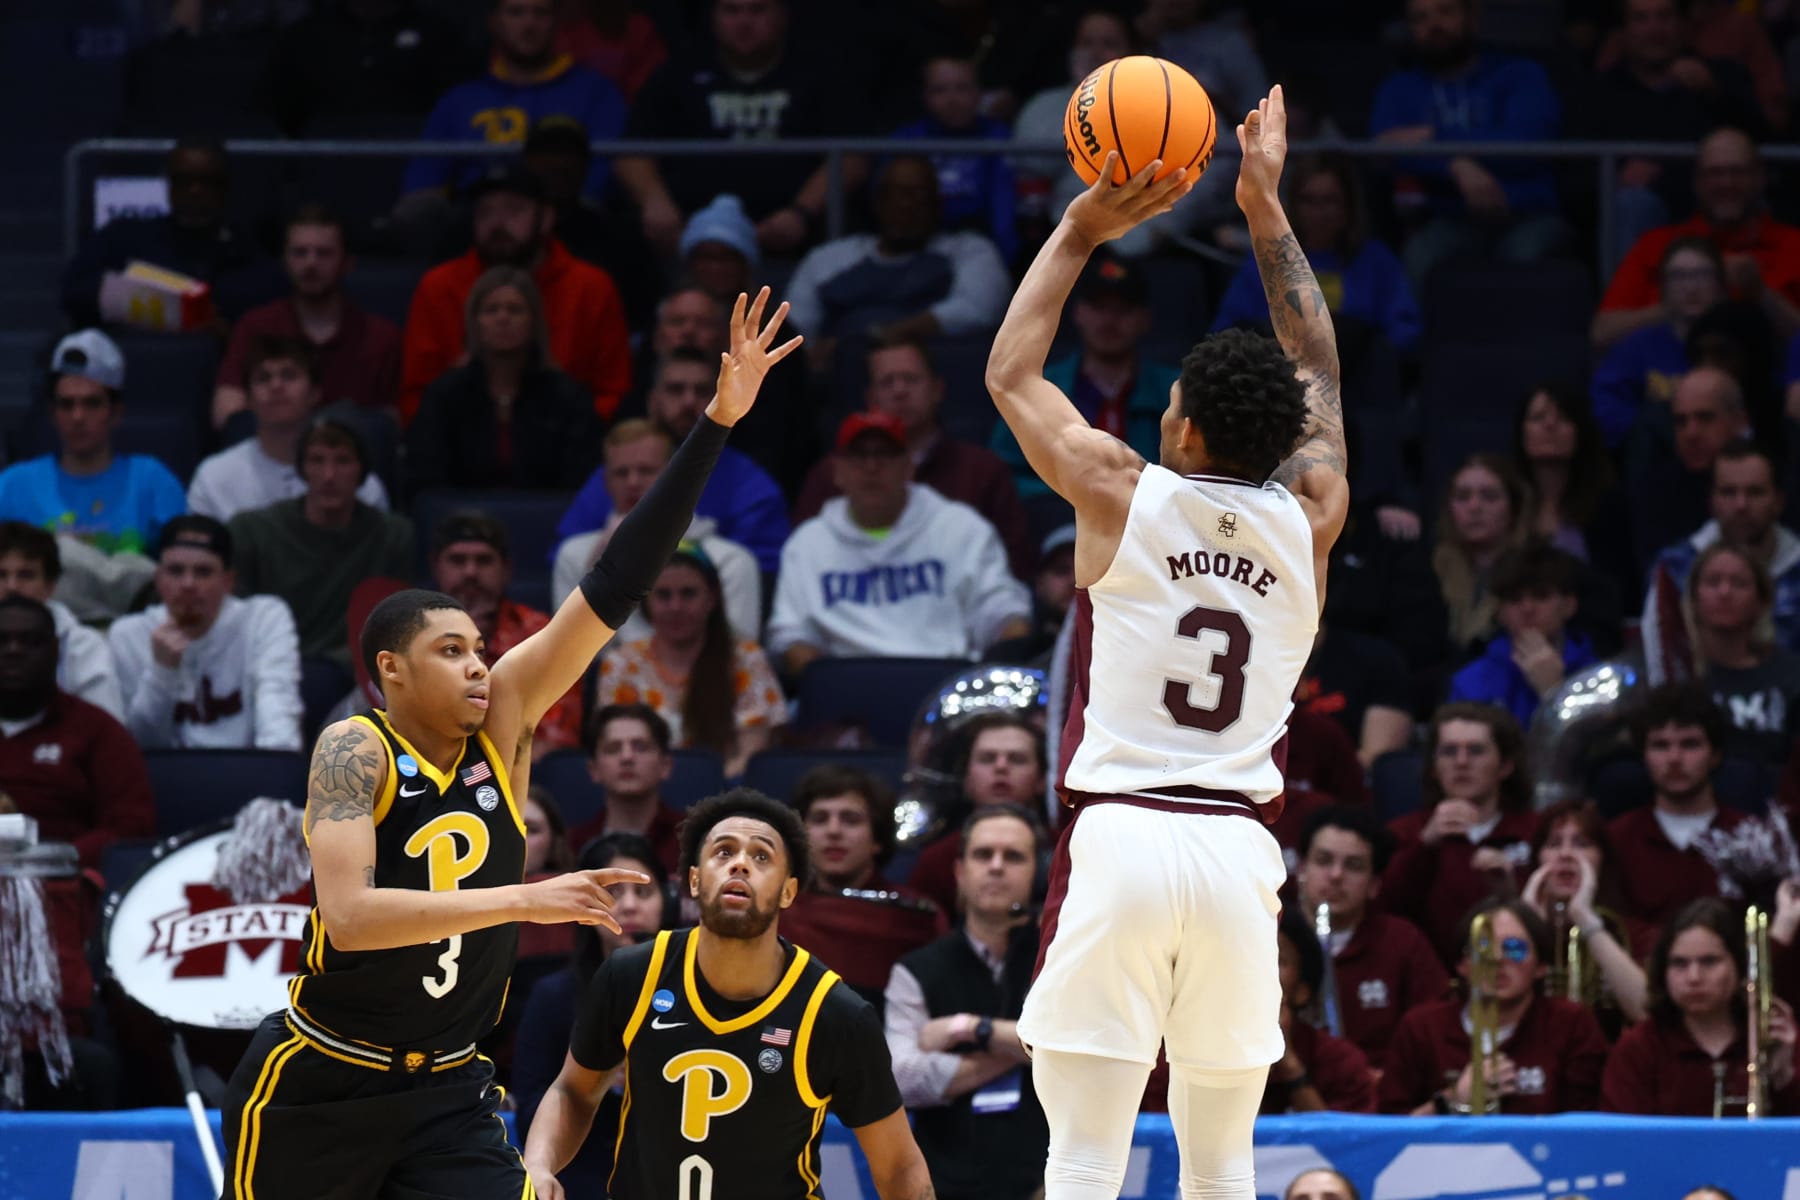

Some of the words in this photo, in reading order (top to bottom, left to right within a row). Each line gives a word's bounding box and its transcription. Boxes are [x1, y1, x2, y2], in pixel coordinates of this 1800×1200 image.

[1166, 550, 1278, 598] MOORE
[1161, 603, 1254, 736] 3
[404, 810, 490, 892] P
[188, 909, 311, 943] STAT
[422, 934, 463, 999] 3
[662, 1048, 753, 1142] P
